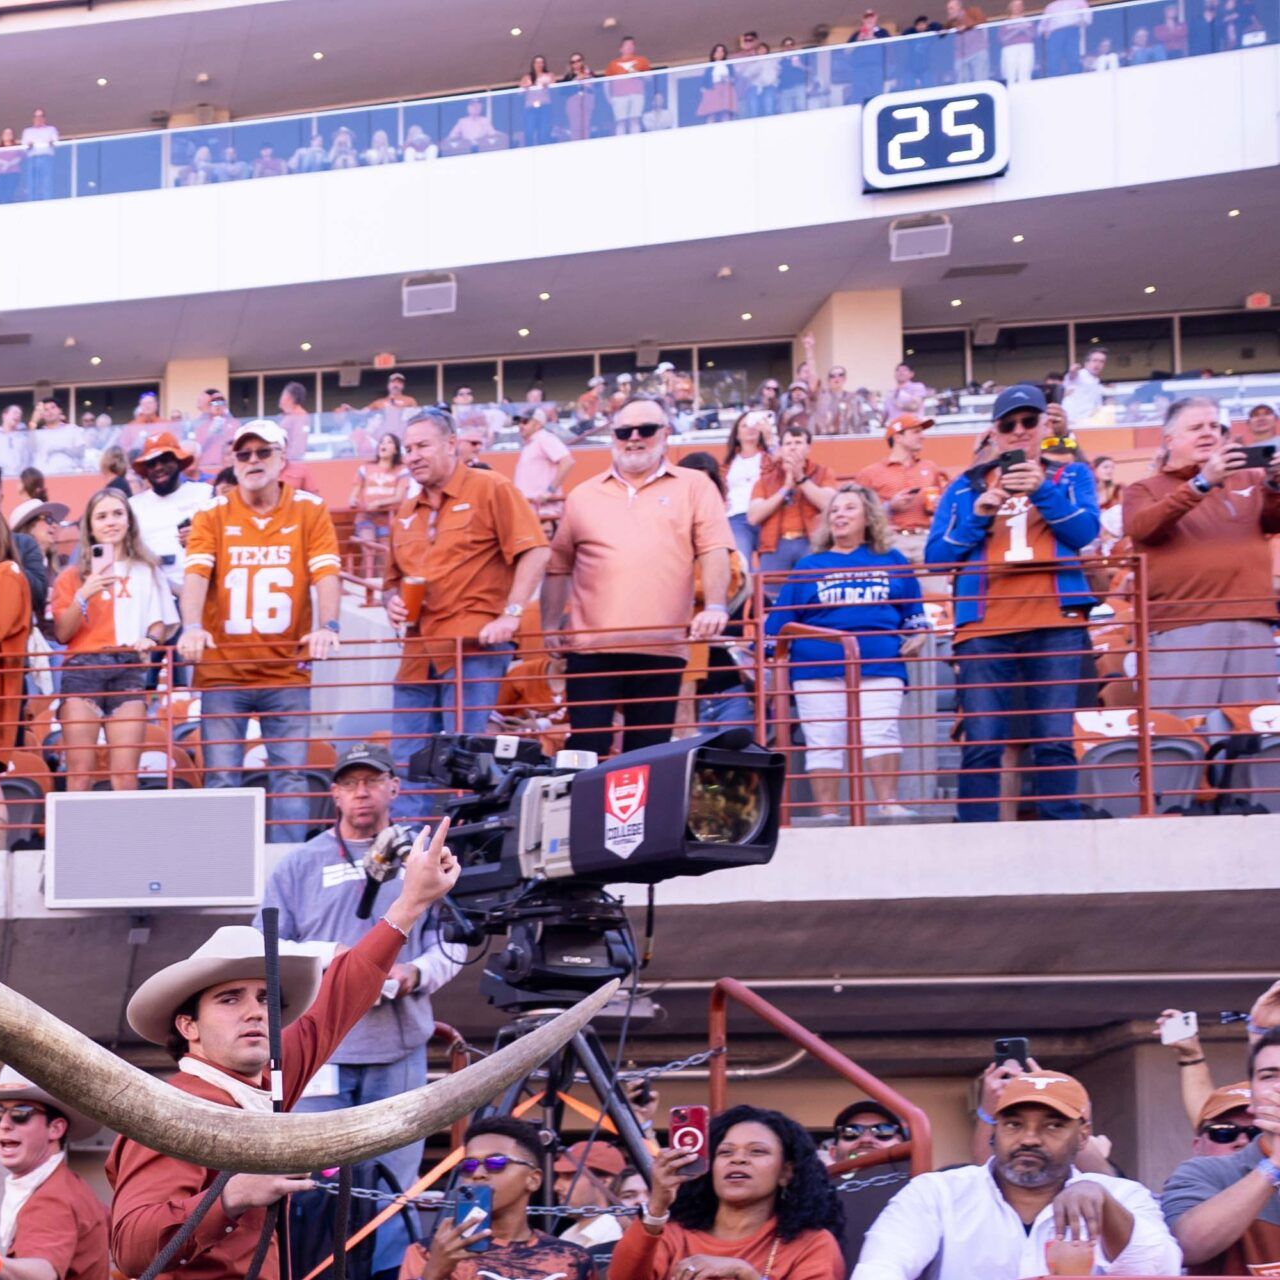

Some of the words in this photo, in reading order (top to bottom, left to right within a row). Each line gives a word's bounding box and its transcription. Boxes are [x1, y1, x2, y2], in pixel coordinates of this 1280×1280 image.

[887, 98, 985, 171] 25
[227, 545, 292, 566] TEXAS
[1003, 511, 1034, 562] 1
[224, 567, 294, 635] 16
